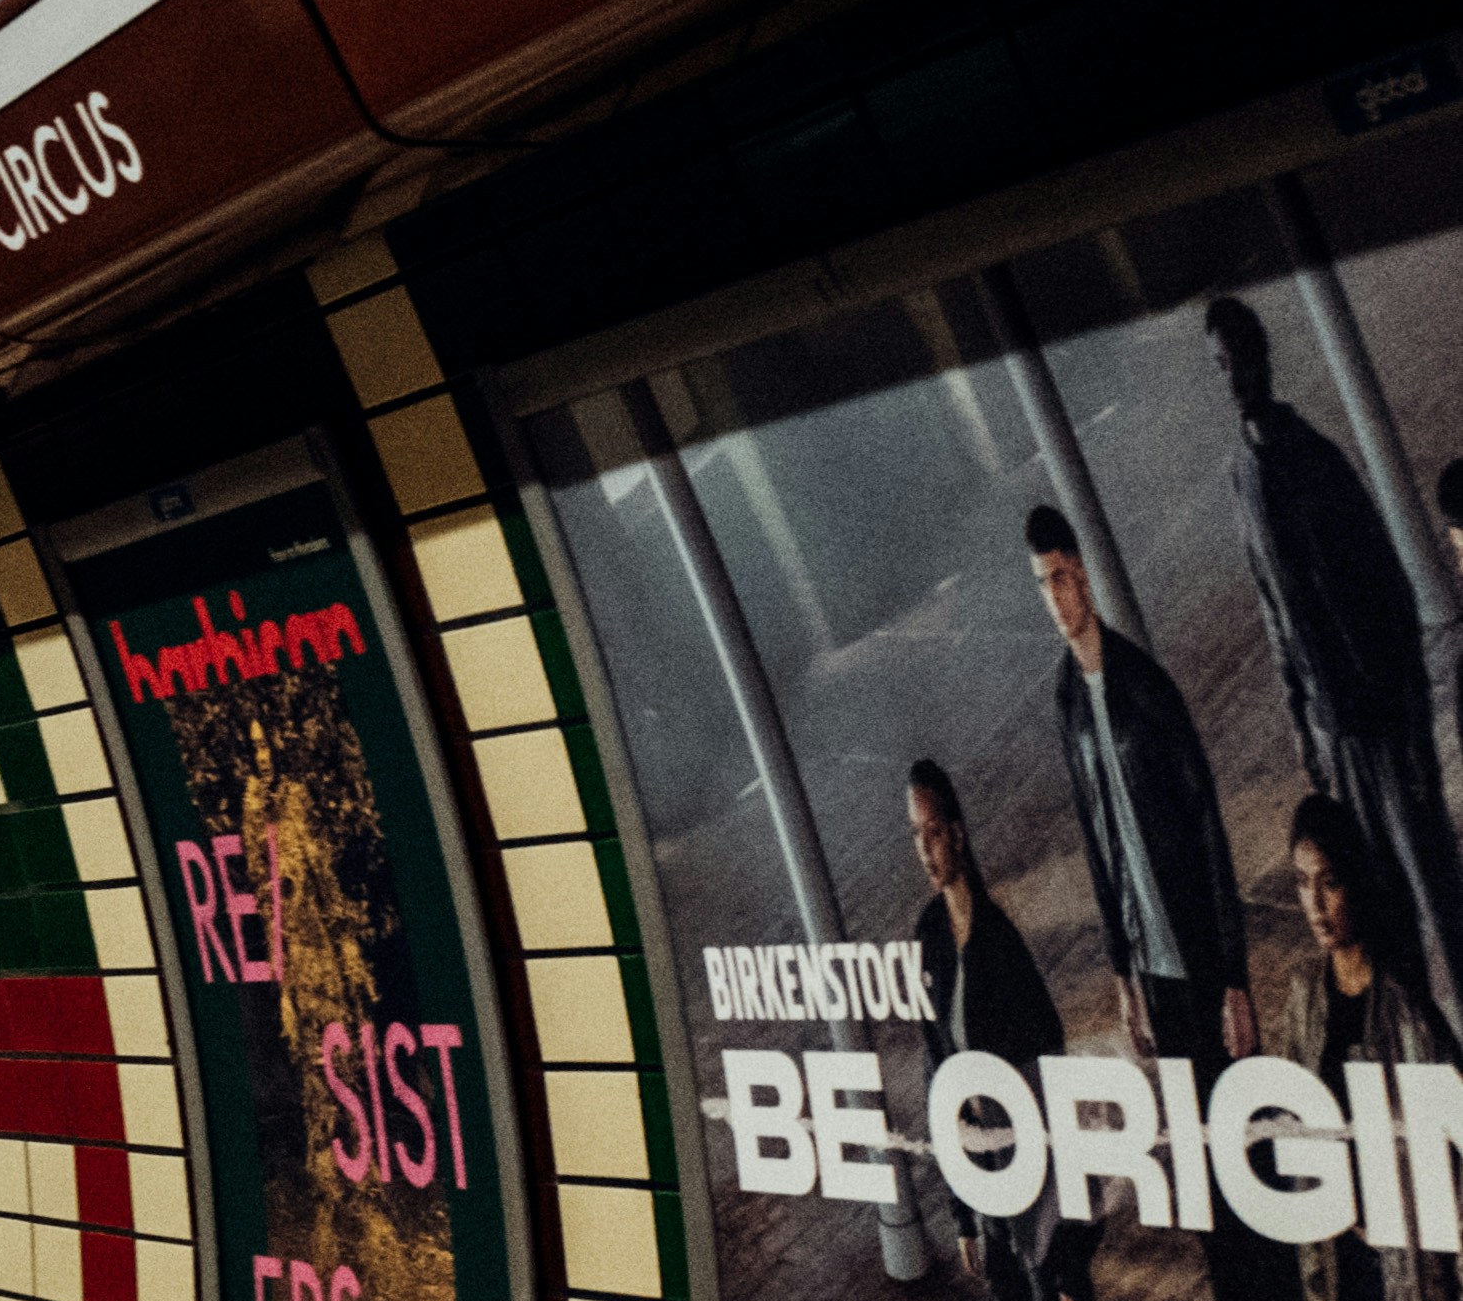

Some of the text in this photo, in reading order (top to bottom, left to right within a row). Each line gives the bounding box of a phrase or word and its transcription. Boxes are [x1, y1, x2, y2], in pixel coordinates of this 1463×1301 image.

[702, 940, 936, 1021] BIRKENSTOCK
[321, 1020, 468, 1190] SIST
[721, 1048, 899, 1204] BE
